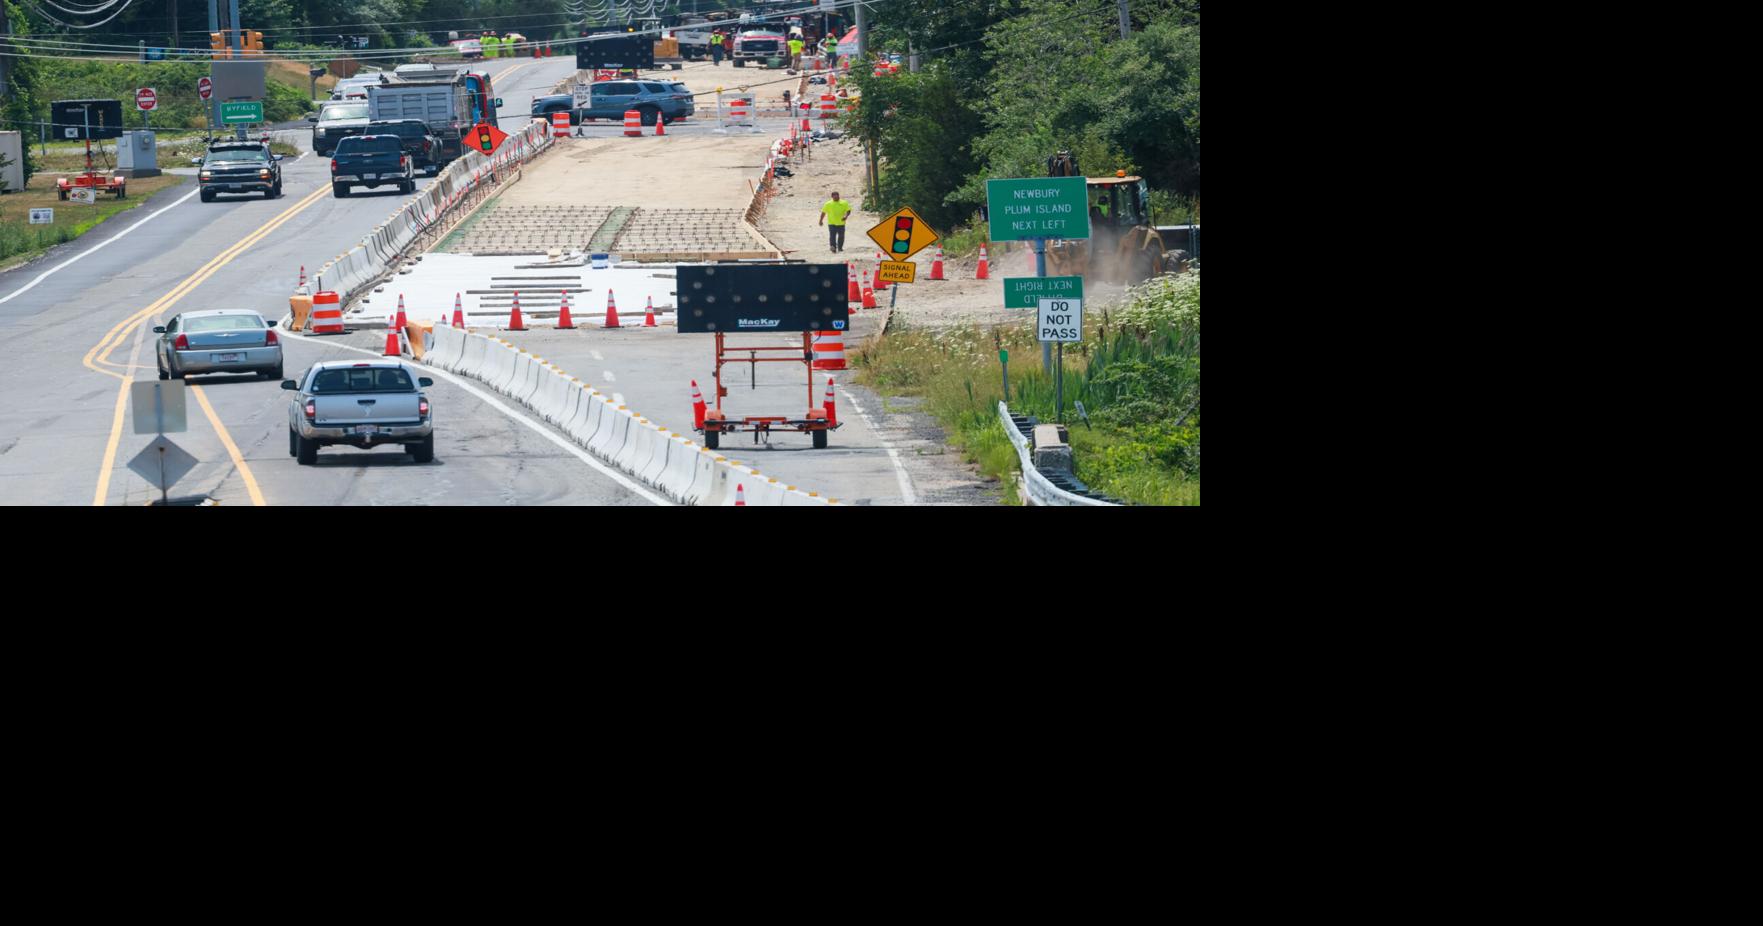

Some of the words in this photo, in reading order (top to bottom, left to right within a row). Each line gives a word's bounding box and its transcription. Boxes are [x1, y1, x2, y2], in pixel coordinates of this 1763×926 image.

[1013, 188, 1060, 199] NEWBURY
[1004, 205, 1031, 215] PLUM
[1036, 204, 1072, 213] ISLAND
[1012, 220, 1037, 230] NEXT
[1042, 219, 1066, 229] LEFT
[883, 264, 910, 272] SIGNAL
[1015, 281, 1043, 291] RIGHT
[1048, 280, 1073, 290] NEXT
[1051, 301, 1069, 311] DO
[738, 318, 780, 327] MacKay
[1046, 314, 1073, 325] NOT
[1042, 328, 1078, 339] PASS
